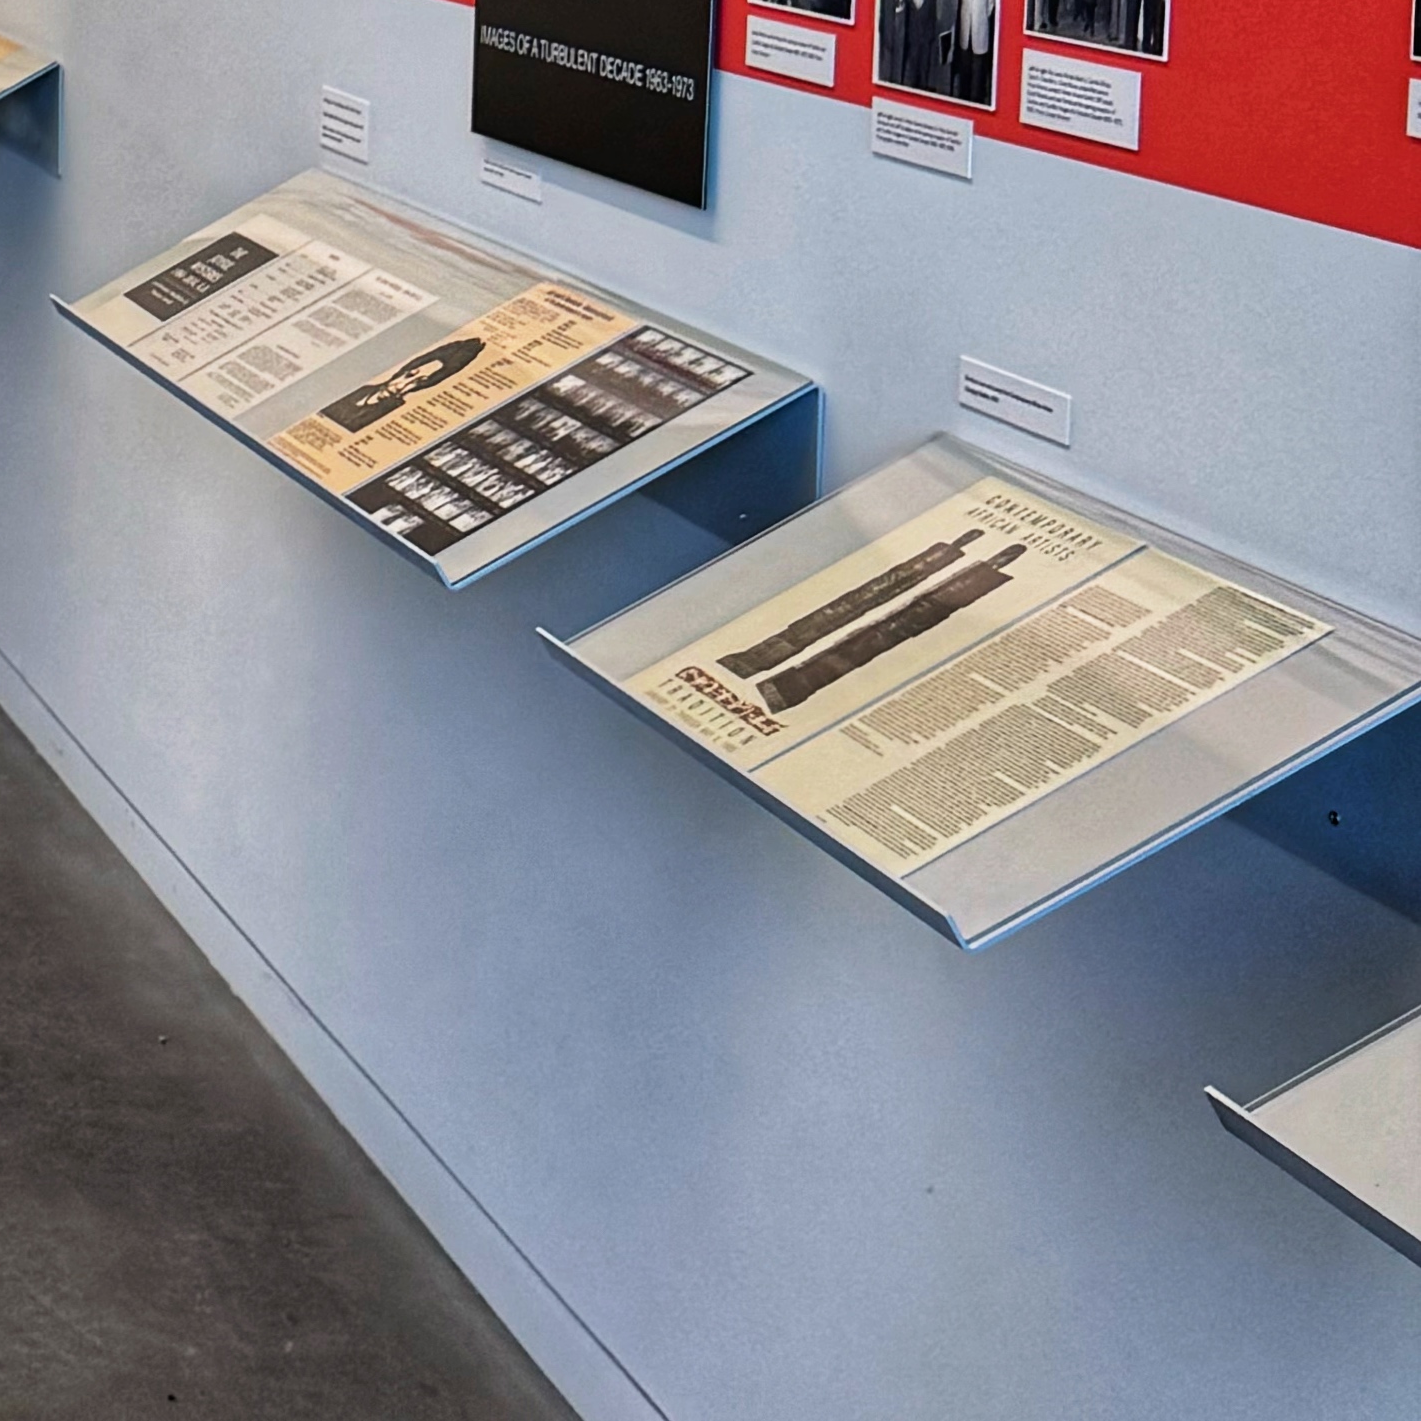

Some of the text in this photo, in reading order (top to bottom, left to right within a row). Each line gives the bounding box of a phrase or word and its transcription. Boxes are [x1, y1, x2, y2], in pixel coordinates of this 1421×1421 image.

[479, 25, 694, 101] IMAGES OF A TURBULENT DECADE 1963-1973
[966, 507, 1076, 562] AFRICAN ARTISTS
[985, 494, 1103, 551] CONTEMPORARY
[658, 678, 757, 746] TRADITION
